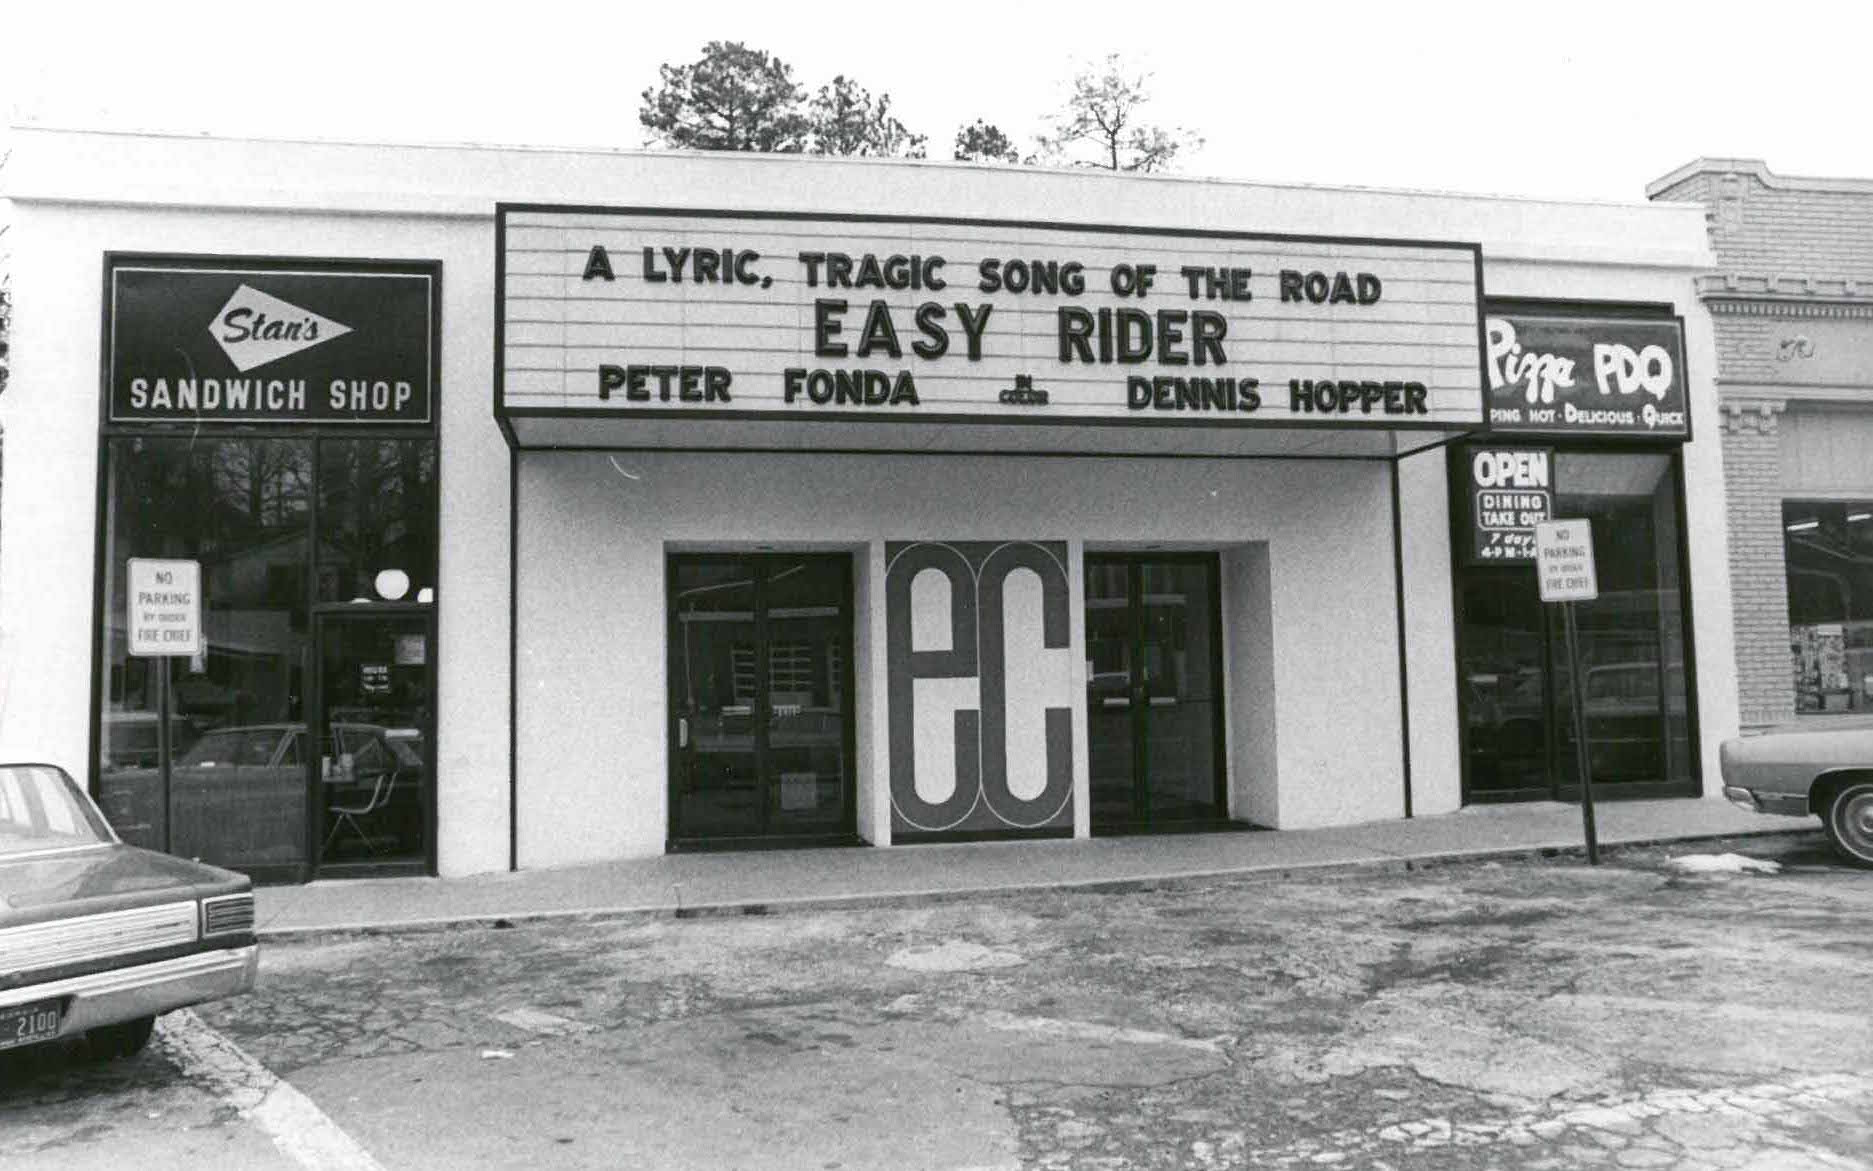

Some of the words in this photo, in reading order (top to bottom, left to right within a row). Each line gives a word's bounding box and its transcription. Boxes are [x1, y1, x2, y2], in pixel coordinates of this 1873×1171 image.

[582, 245, 615, 282] A
[643, 246, 772, 288] LYRIC,
[799, 251, 947, 291] TRAGIC
[978, 258, 1085, 297] SONG
[1110, 263, 1157, 299] OF
[1181, 265, 1252, 302] THE
[1279, 269, 1382, 305] ROAD
[223, 307, 319, 344] Stan's
[815, 298, 993, 361] EASY
[1058, 305, 1228, 366] RIDER
[1485, 318, 1576, 404] Pizza
[1593, 344, 1673, 401] PDQ
[130, 378, 306, 410] SANDWICH
[329, 379, 411, 411] SHOP
[599, 363, 732, 403] PETER
[783, 368, 920, 406] FONDA
[1127, 375, 1260, 412] DENNIS
[1289, 379, 1427, 415] HOPPER
[1490, 408, 1521, 423] PING
[1529, 409, 1556, 424] HOT
[1474, 451, 1549, 487] OPEN
[1483, 495, 1542, 509] DINING
[1482, 511, 1515, 526] TAKE
[1520, 511, 1546, 525] OUT
[1491, 533, 1501, 544] 7
[1504, 533, 1536, 546] day
[1555, 530, 1570, 541] NO
[1544, 545, 1586, 559] PARKING
[155, 570, 173, 584] NO
[138, 591, 191, 606] PARKING
[138, 629, 160, 641] FIRE
[163, 629, 191, 641] CHIEF
[17, 1011, 57, 1037] 2100
